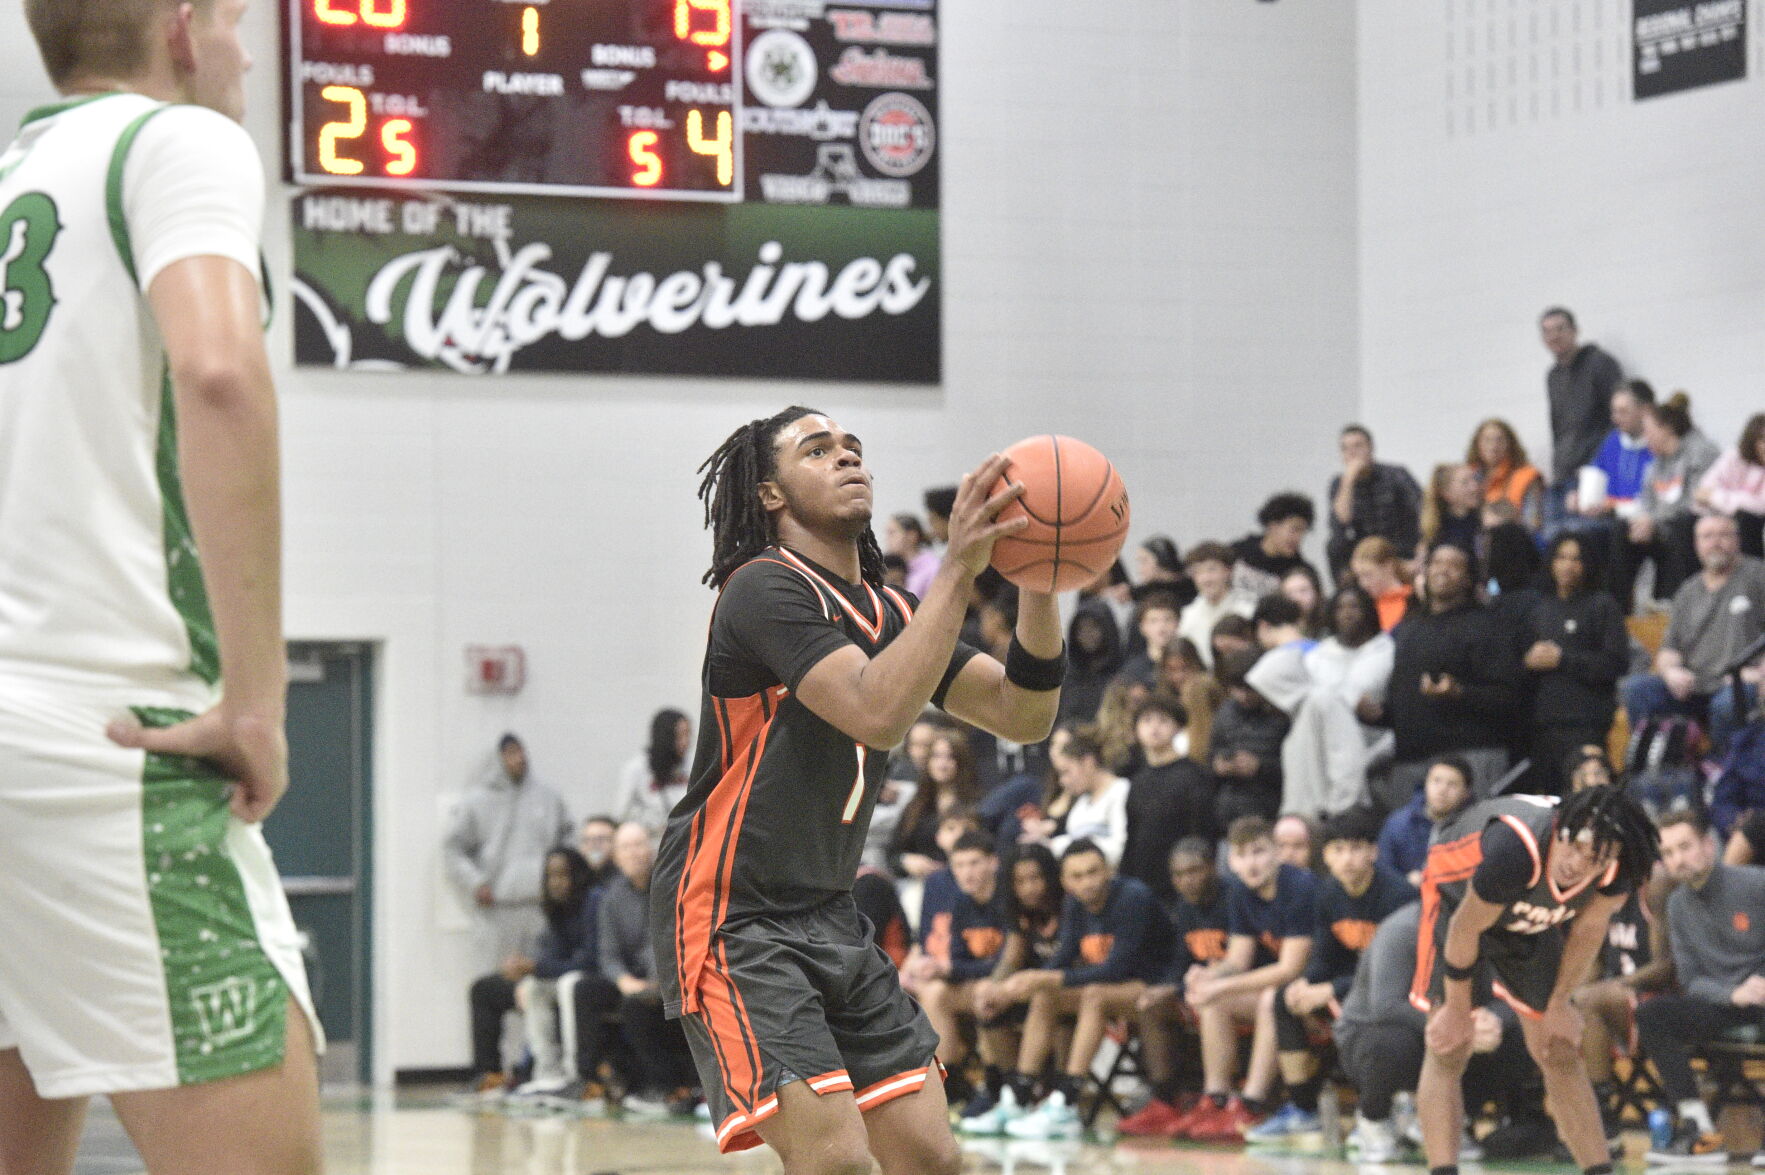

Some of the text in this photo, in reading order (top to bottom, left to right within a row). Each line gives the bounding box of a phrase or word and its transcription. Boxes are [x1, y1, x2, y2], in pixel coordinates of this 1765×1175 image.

[384, 33, 451, 58] BONUS
[523, 7, 539, 56] 1
[591, 43, 656, 69] BONUS
[482, 70, 565, 96] PLAYER
[665, 80, 733, 104] FOULS
[319, 86, 366, 174] 2
[381, 118, 416, 175] 5
[687, 109, 732, 186] 4
[628, 130, 662, 186] 5
[303, 196, 513, 239] HOME OF THE
[365, 241, 930, 359] Wolverines
